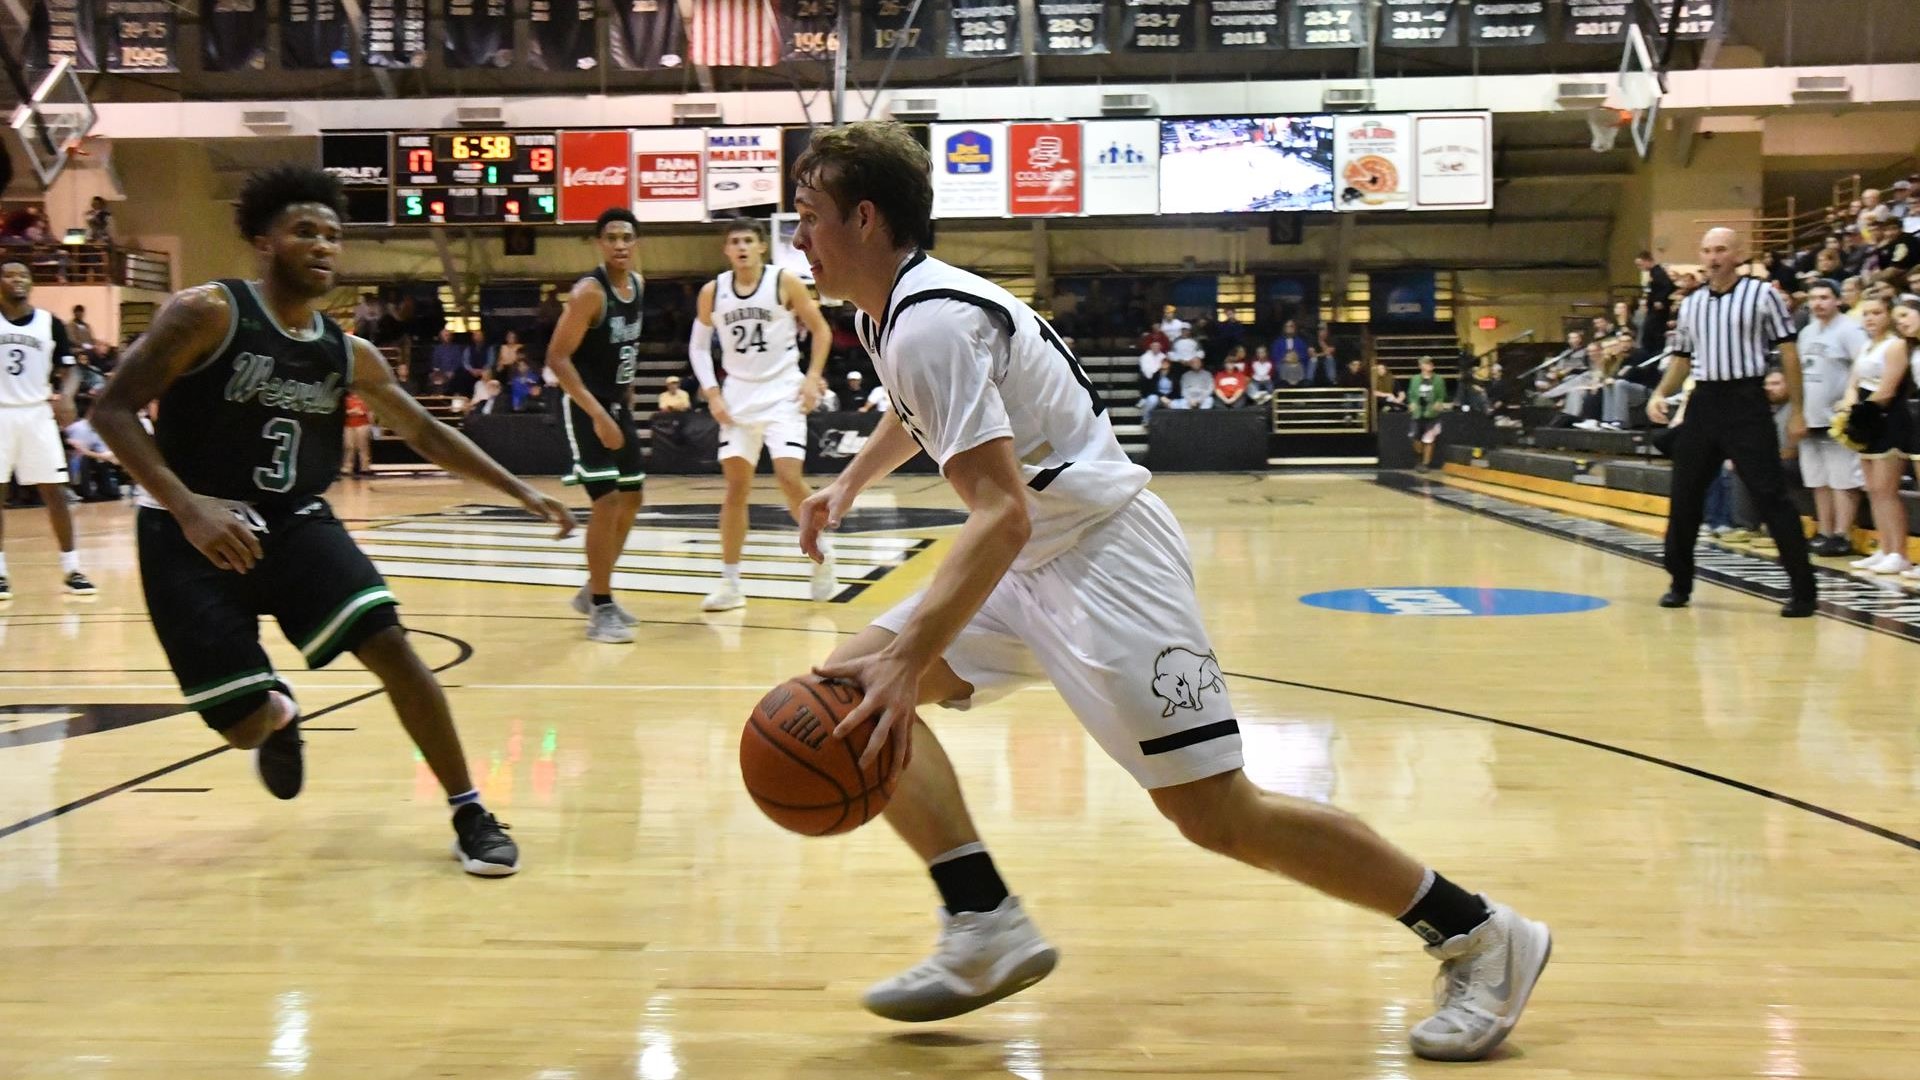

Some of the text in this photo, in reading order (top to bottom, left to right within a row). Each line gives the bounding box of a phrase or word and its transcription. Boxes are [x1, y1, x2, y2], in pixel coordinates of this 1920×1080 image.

[1304, 10, 1352, 26] 23-7
[1305, 28, 1351, 43] 2015
[1392, 27, 1445, 40] 2017
[1481, 24, 1536, 38] 2017
[1575, 21, 1622, 36] 2017
[963, 37, 1007, 52] 2014
[1048, 36, 1093, 49] 2014
[1222, 31, 1267, 45] 2015
[452, 136, 511, 159] 6:58
[710, 135, 761, 147] MARK
[710, 150, 777, 161] MARTIN
[656, 158, 697, 171] FARM
[407, 196, 423, 216] 5
[731, 323, 768, 353] 24
[7, 348, 25, 376] 3
[252, 416, 302, 493] 3
